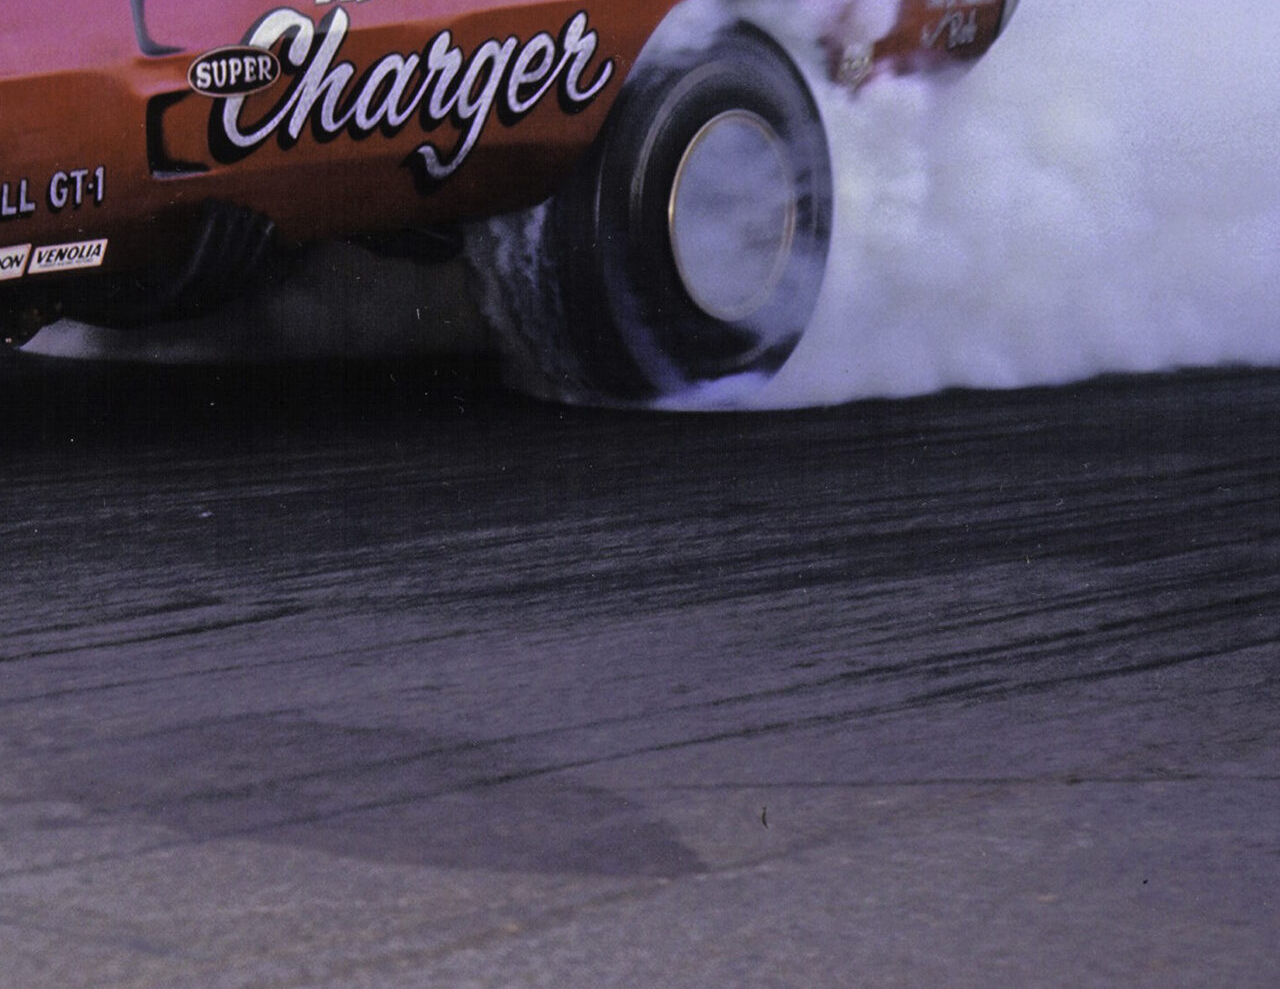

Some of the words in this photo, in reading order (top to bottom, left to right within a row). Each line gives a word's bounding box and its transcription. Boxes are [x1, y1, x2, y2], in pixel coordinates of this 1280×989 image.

[195, 54, 273, 89] SUPER
[220, 6, 616, 181] Charger
[36, 243, 102, 264] VENOLIA
